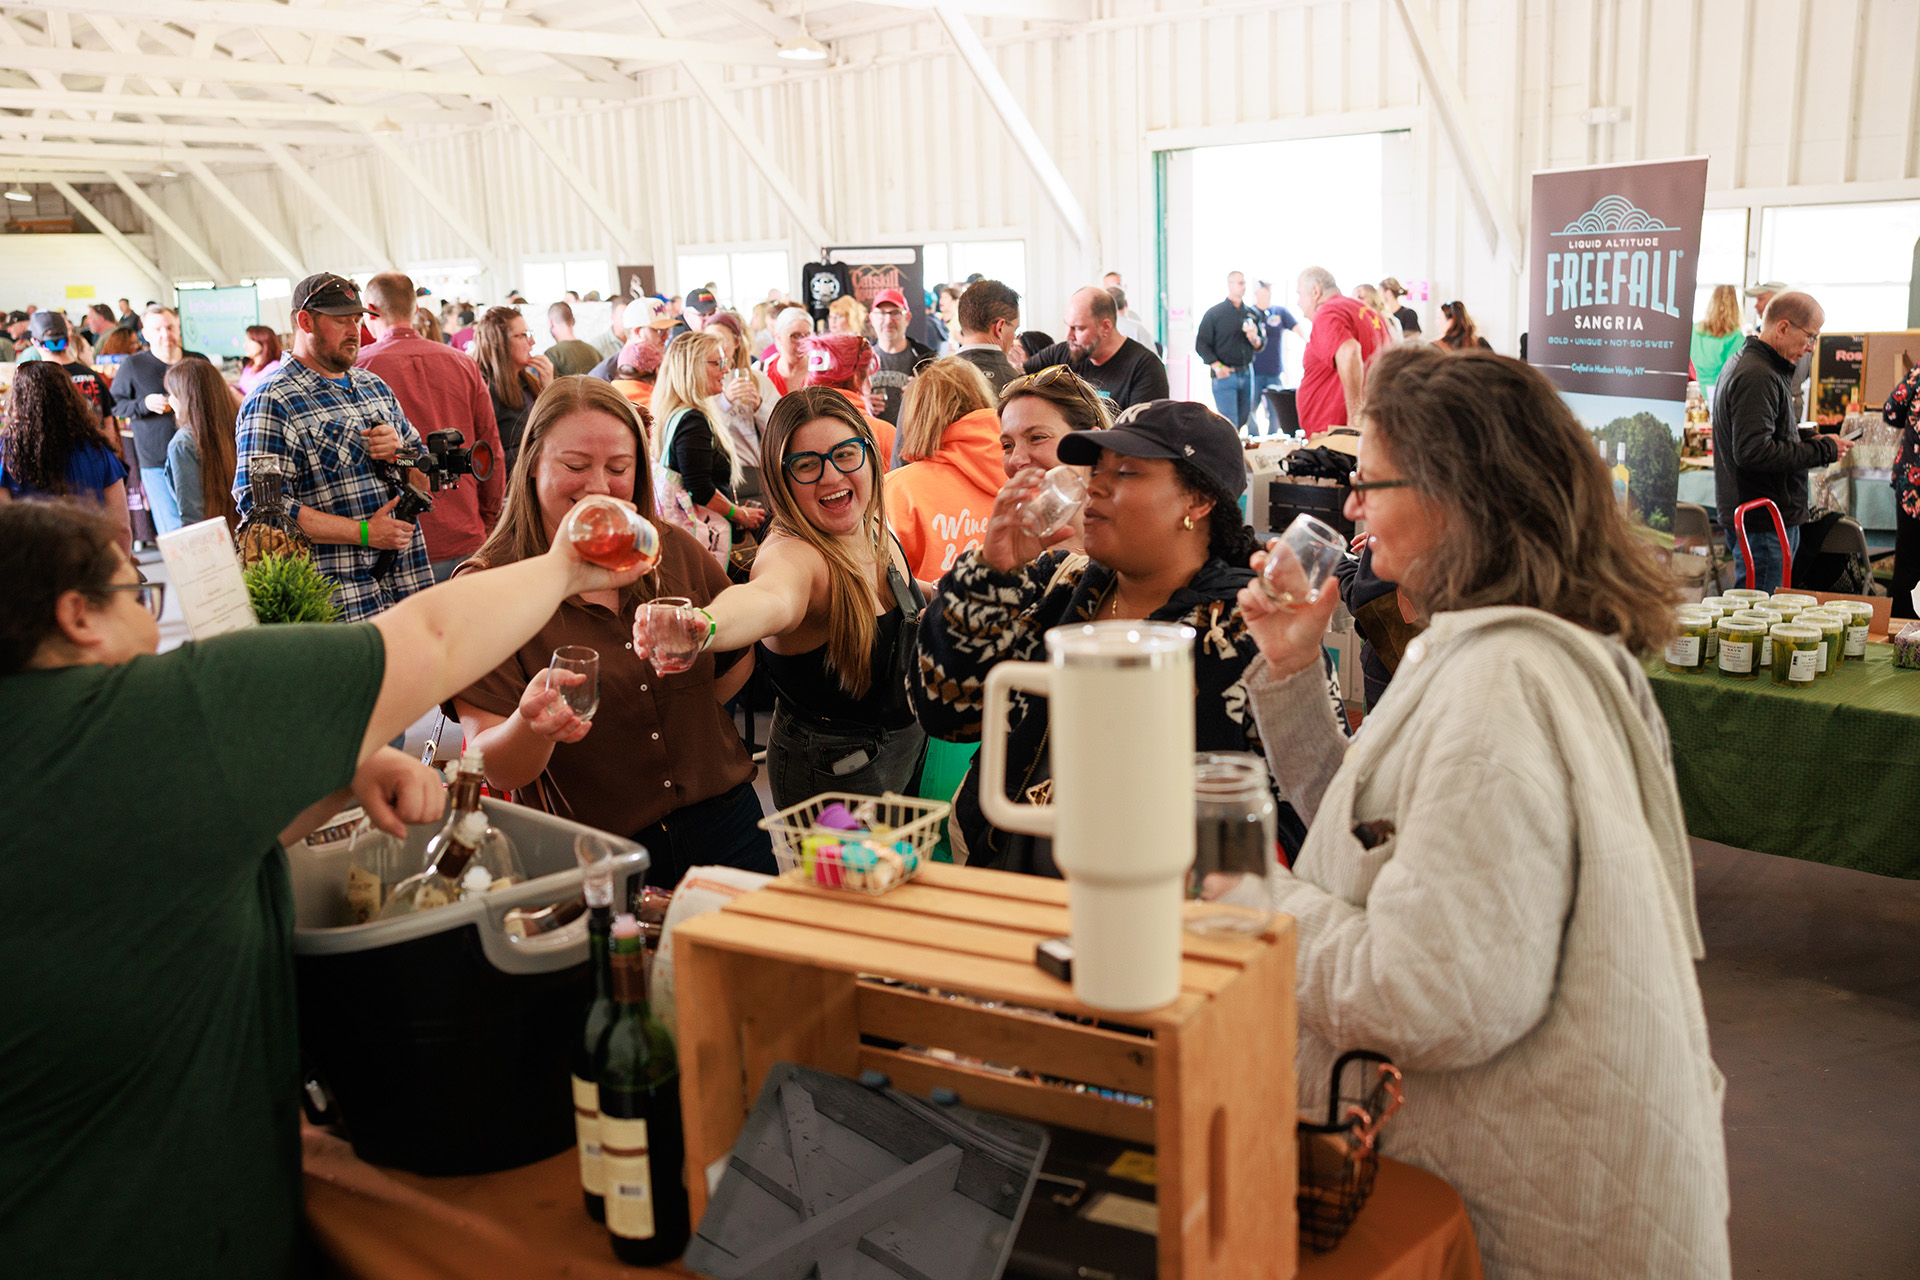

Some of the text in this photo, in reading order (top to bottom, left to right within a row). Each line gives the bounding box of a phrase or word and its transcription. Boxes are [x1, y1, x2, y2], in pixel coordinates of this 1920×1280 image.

[1568, 237, 1659, 249] LIQUID ALTITUDE
[1545, 249, 1680, 319] FREEFALL
[1574, 314, 1644, 331] SANGRIA
[1547, 336, 1569, 345] BOLD
[1574, 337, 1602, 347] UNIQUE
[1634, 367, 1645, 375] NY
[932, 508, 989, 541] Wine
